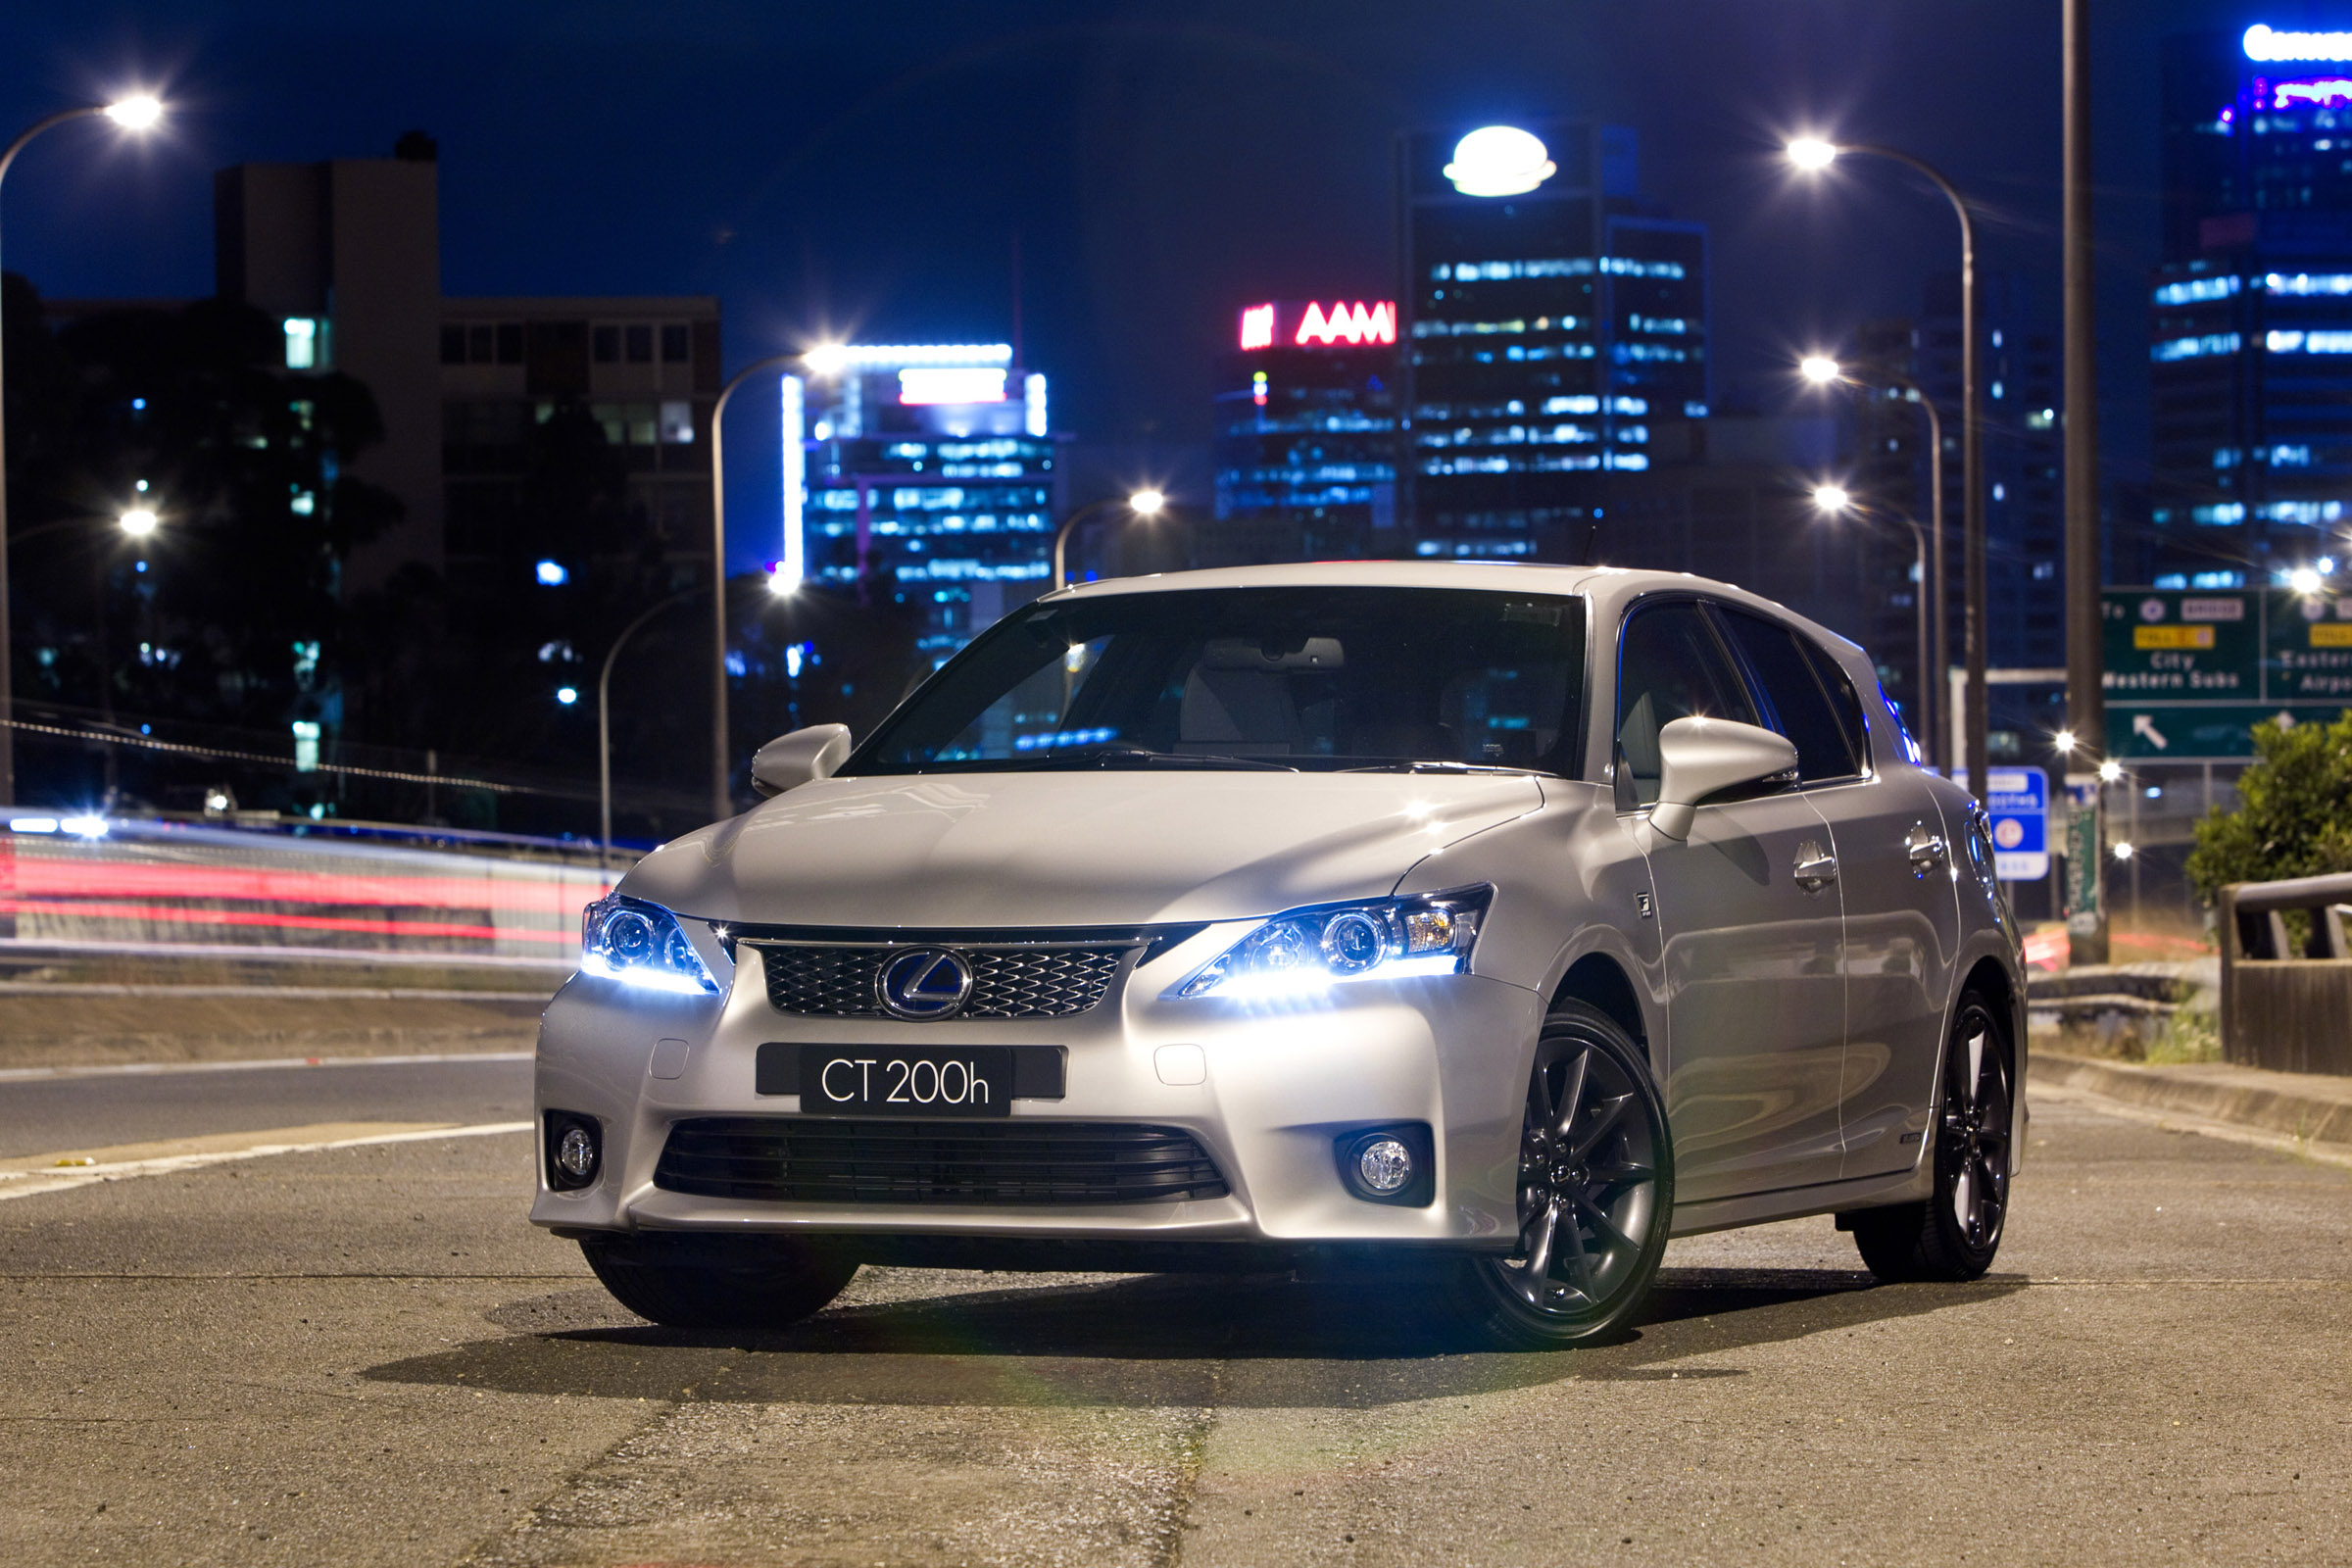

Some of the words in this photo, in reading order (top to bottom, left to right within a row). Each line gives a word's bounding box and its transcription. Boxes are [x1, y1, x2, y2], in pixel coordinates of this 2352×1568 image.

[2149, 650, 2195, 670] City
[2279, 650, 2352, 668] Easter
[2189, 669, 2239, 688] Subs
[821, 1058, 877, 1102] CT
[885, 1058, 989, 1104] 200h
